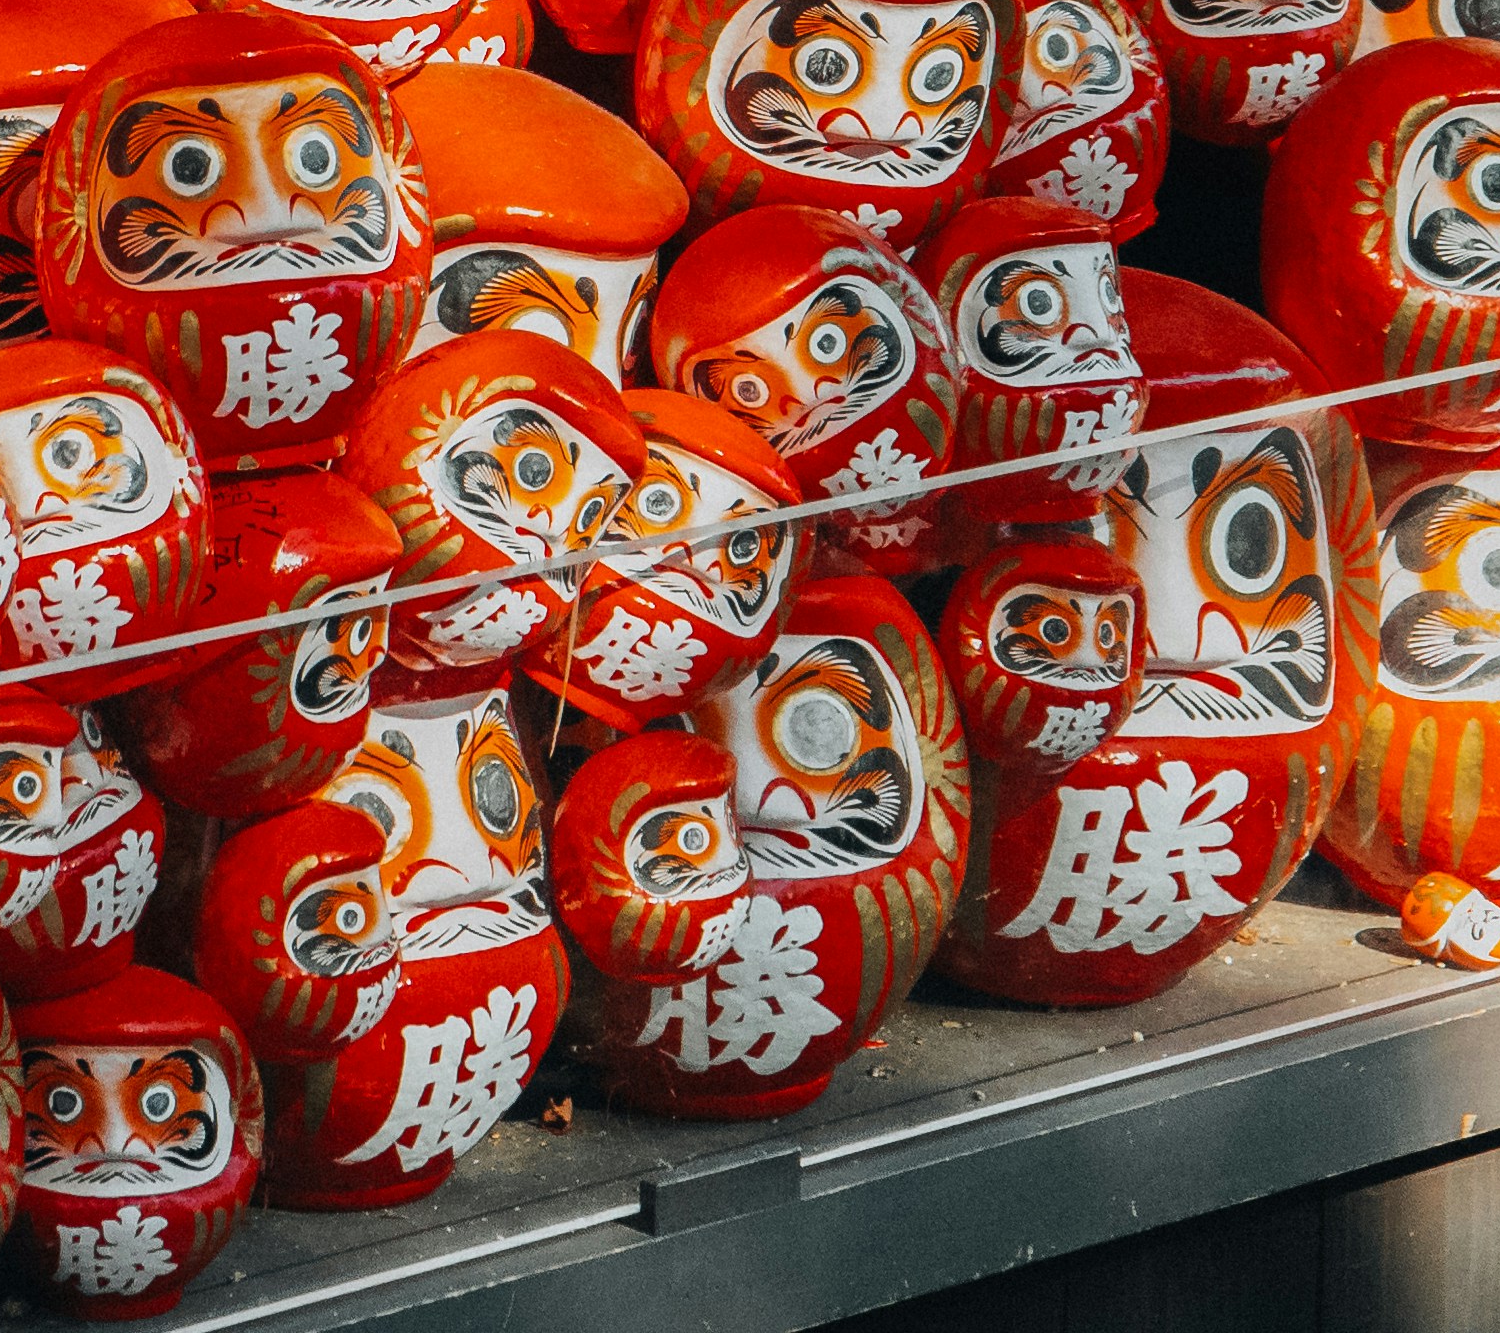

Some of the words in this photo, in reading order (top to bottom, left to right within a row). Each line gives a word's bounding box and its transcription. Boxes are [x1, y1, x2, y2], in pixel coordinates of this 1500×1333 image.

[214, 304, 353, 429] 勝
[1052, 391, 1140, 491] 勝
[9, 558, 134, 661] 勝
[574, 605, 708, 702] 勝
[1028, 702, 1110, 760] 勝
[75, 828, 159, 947] 勝
[1001, 760, 1248, 956] 勝
[337, 962, 402, 1042] 勝
[637, 895, 842, 1076] 勝
[335, 983, 537, 1173] 勝
[54, 1206, 177, 1298] 勝
